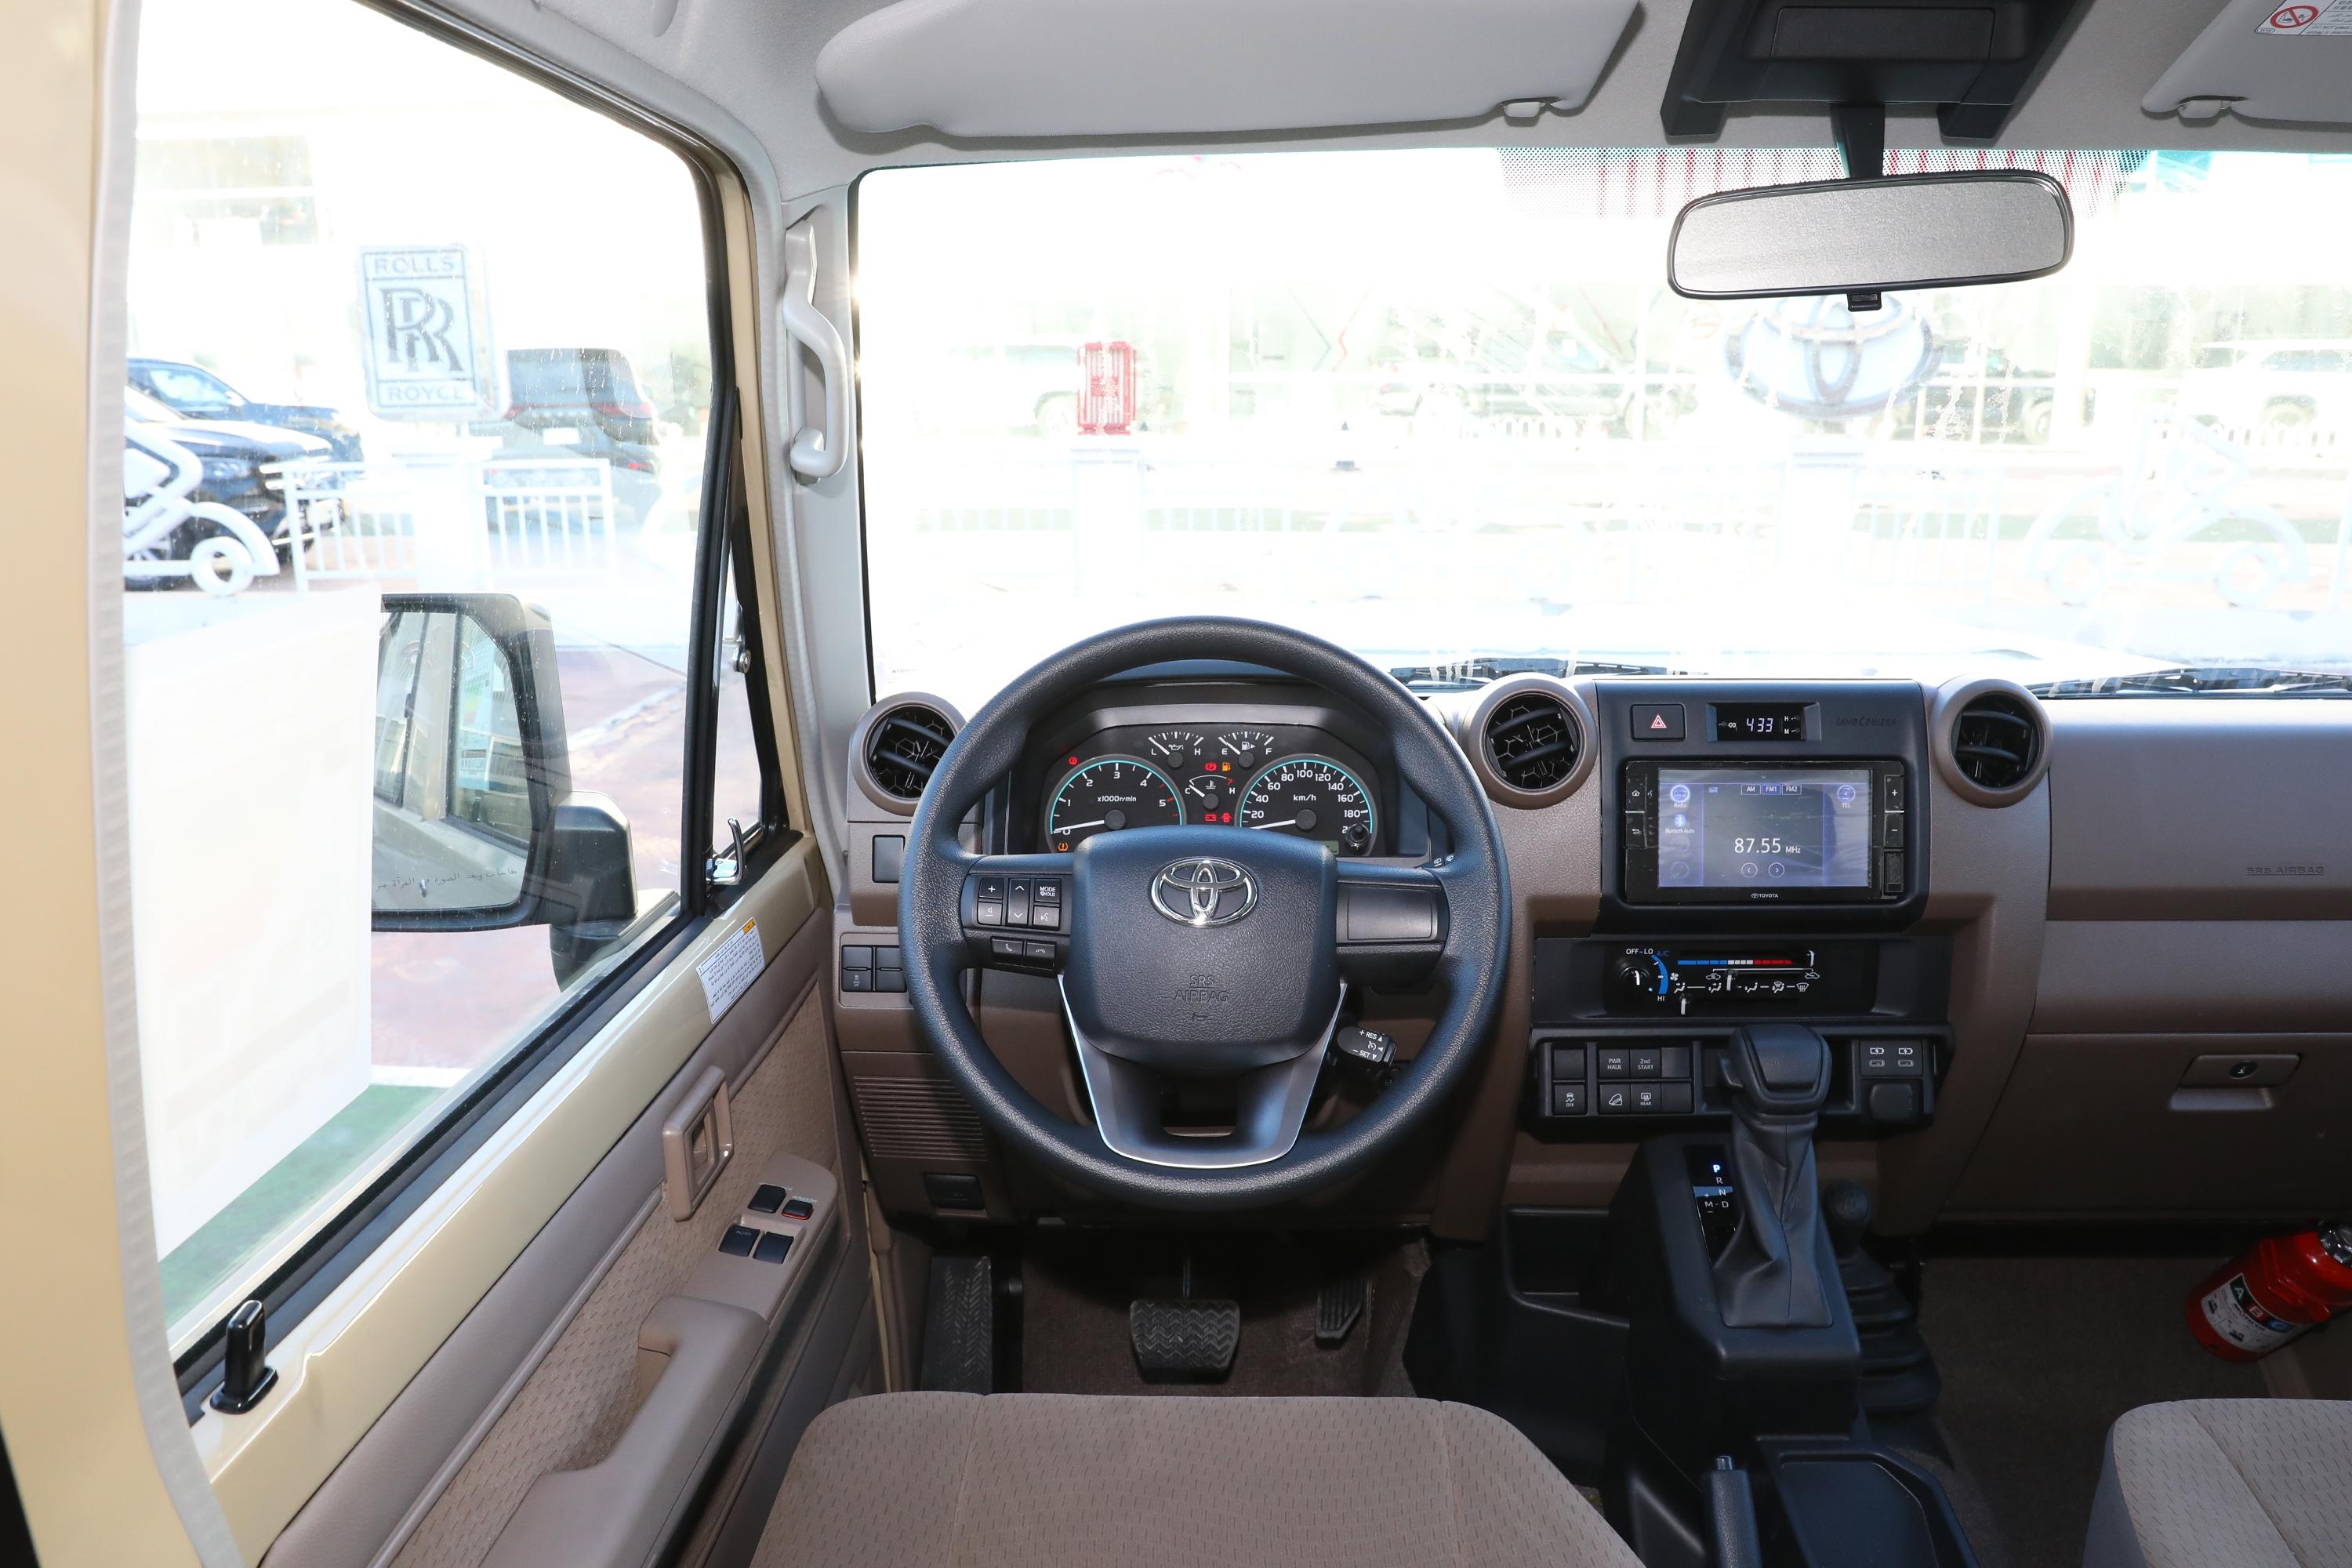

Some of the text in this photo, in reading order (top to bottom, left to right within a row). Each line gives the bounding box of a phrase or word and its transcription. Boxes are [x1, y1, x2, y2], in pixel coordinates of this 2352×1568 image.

[374, 256, 455, 274] ROLLS
[1281, 773, 1294, 781] 80
[1296, 769, 1313, 778] 100
[1315, 773, 1331, 781] 120
[1086, 779, 1094, 787] 2
[1267, 782, 1281, 791] 60
[1328, 783, 1344, 791] 140
[1255, 794, 1269, 803] 40
[1338, 794, 1354, 803] 160
[1251, 810, 1264, 818] 20
[1344, 809, 1361, 818] 180
[1734, 837, 1781, 854] 87.55
[1189, 975, 1214, 986] SRS
[1174, 990, 1229, 1004] AIRBAG
[1365, 1031, 1377, 1040] RES
[1359, 1050, 1371, 1058] SET
[1713, 1164, 1721, 1173] P
[2235, 1287, 2245, 1300] A
